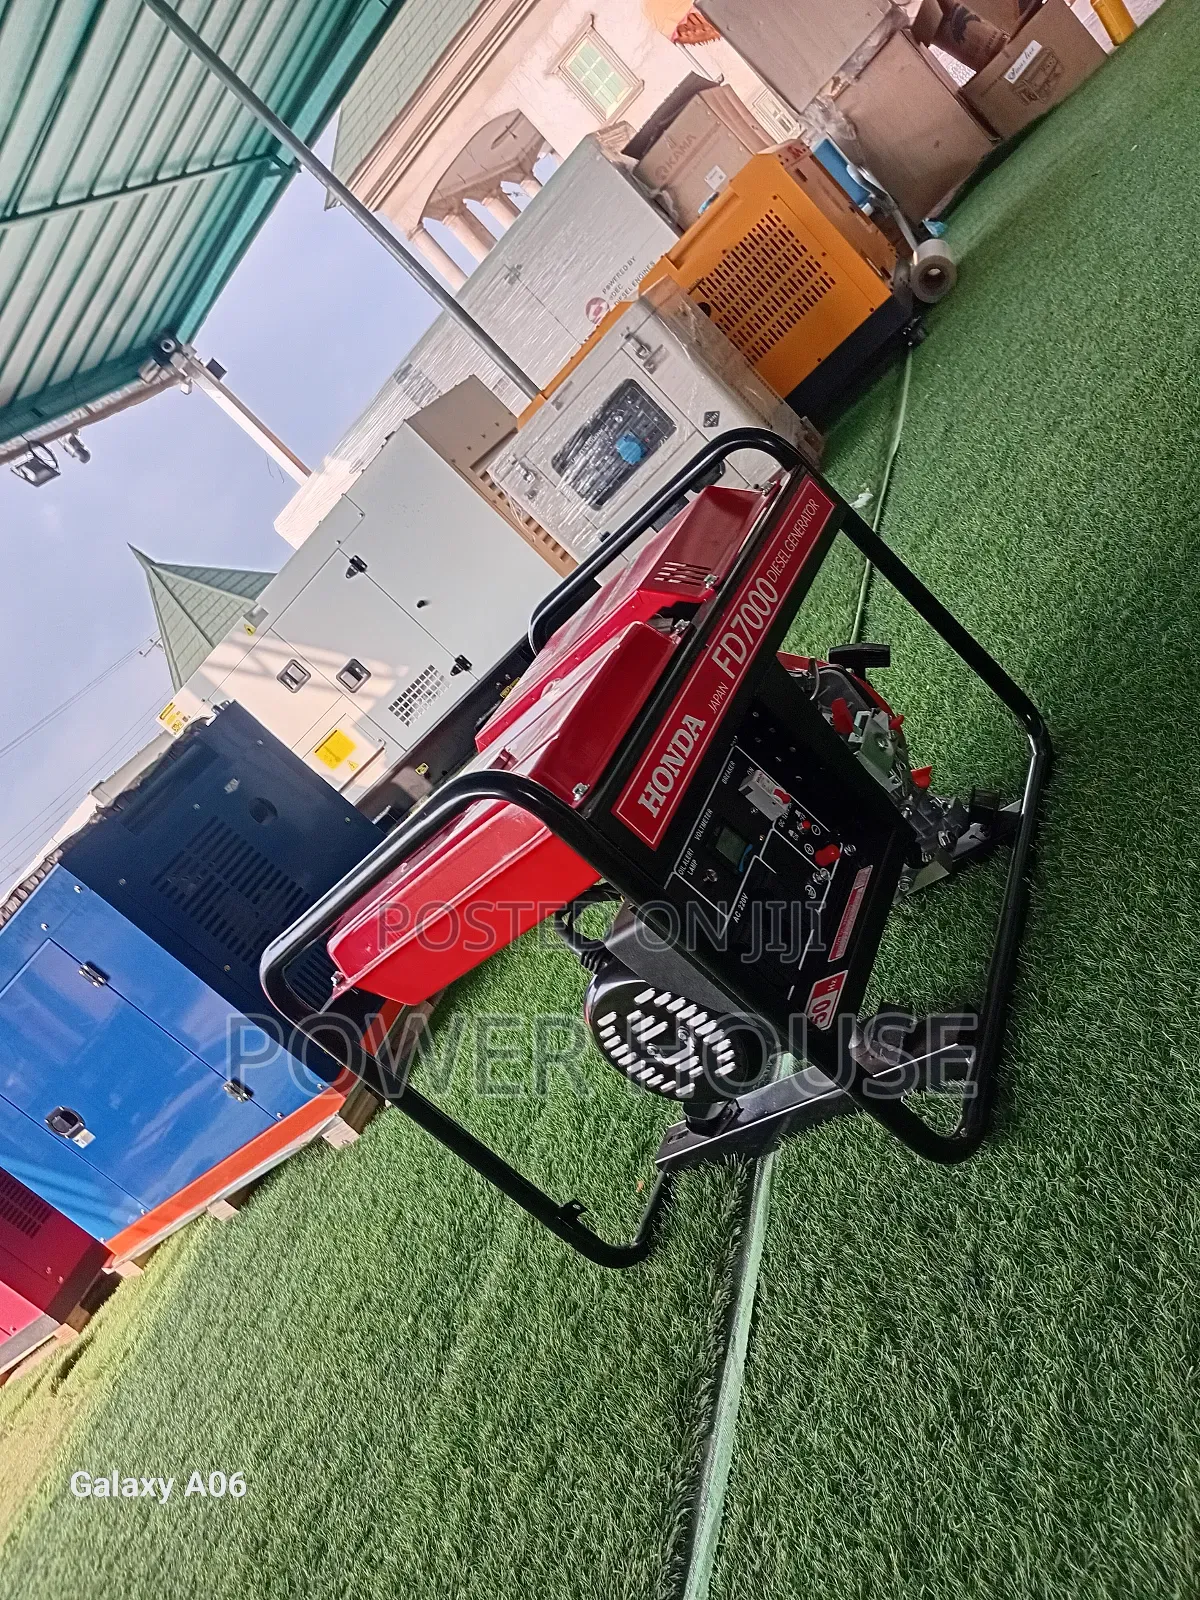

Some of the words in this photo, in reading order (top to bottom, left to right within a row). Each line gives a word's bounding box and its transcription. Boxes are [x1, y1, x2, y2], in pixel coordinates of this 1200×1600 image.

[665, 133, 697, 170] KAMA
[602, 264, 629, 294] POWERED
[627, 255, 637, 267] BY
[631, 260, 656, 288] ENGINES
[785, 498, 820, 550] GENERATOR
[765, 546, 792, 583] DIESEL
[711, 577, 779, 679] FD7000
[707, 681, 730, 714] JAPAN
[638, 713, 706, 819] HONDA
[721, 760, 736, 785] BREAKER
[694, 808, 713, 841] VOLTMETER
[683, 847, 695, 865] ALERT
[687, 859, 698, 876] LAMP
[733, 911, 742, 924] AC
[738, 892, 749, 912] 220V
[812, 1000, 831, 1025] 50
[827, 979, 837, 991] Hz
